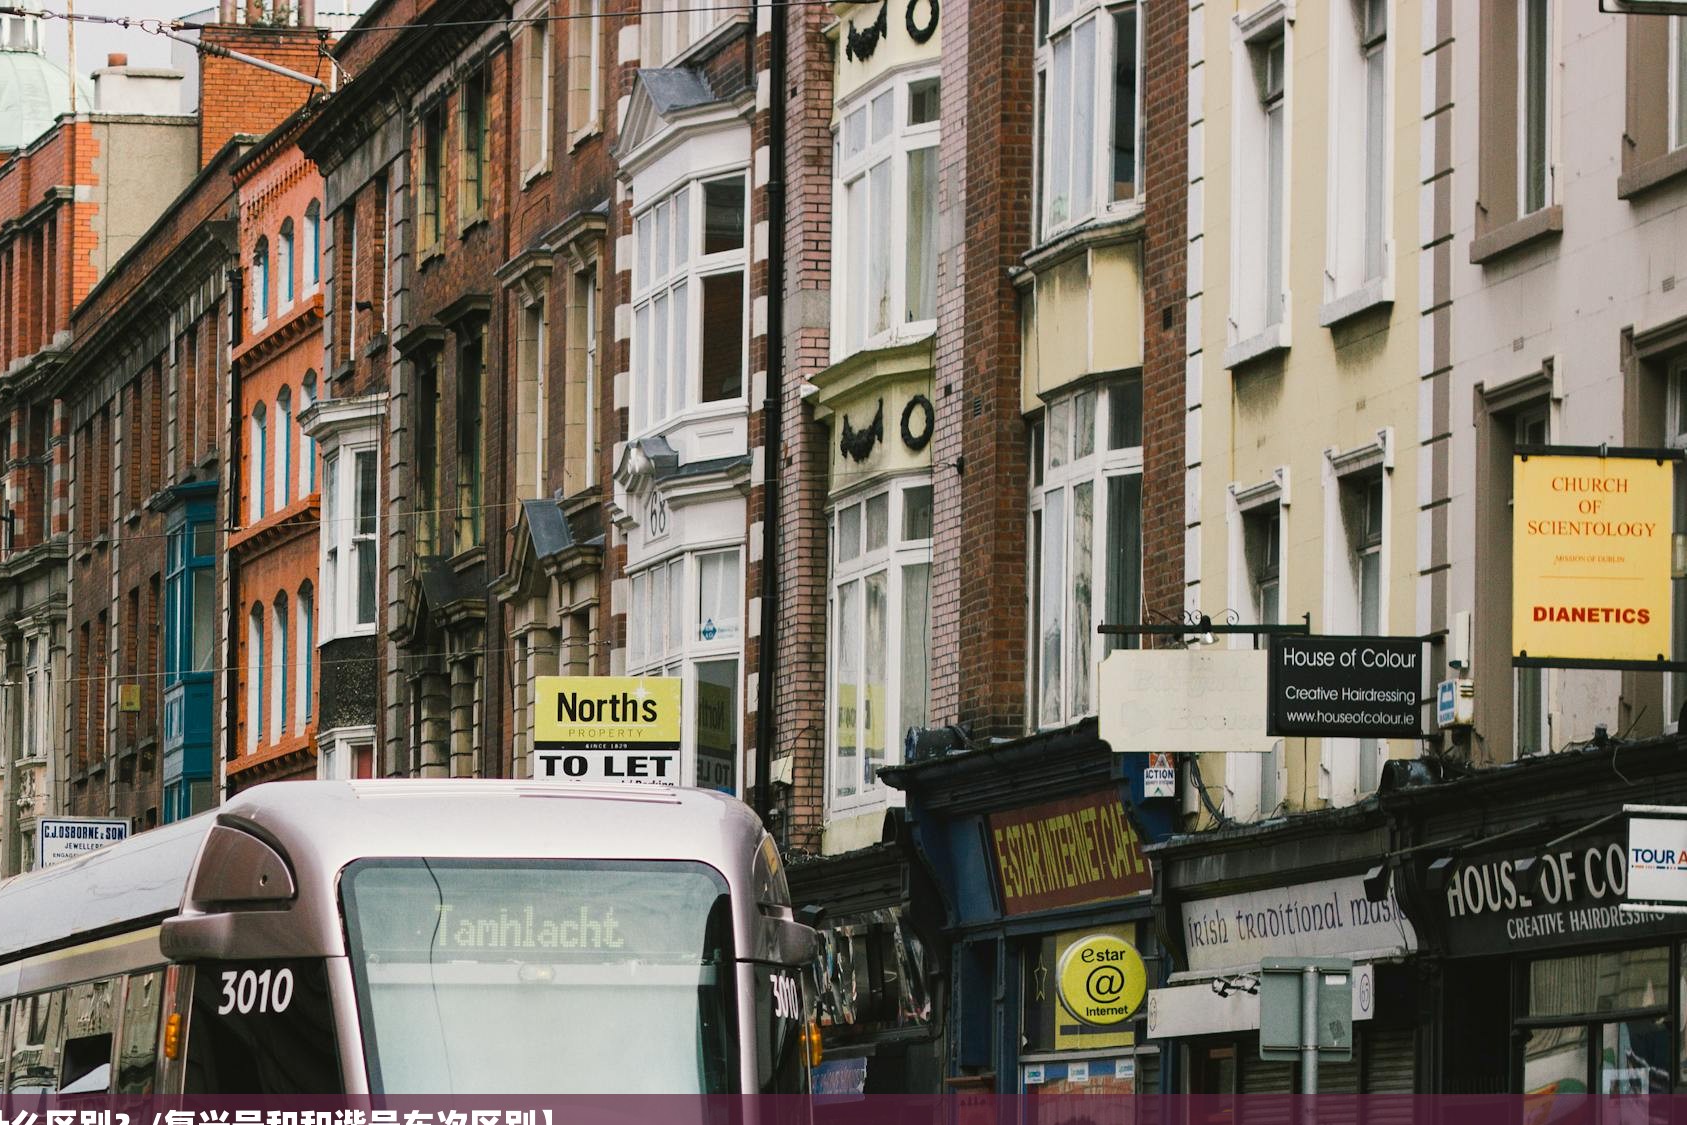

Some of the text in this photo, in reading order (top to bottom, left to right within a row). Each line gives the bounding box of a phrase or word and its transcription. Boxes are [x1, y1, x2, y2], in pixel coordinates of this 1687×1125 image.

[1552, 477, 1628, 493] CHURCH
[650, 491, 666, 536] 68
[1578, 499, 1602, 514] OF
[1527, 520, 1656, 538] SCIENTOLOGY
[1533, 606, 1651, 625] DIANETICS
[1283, 647, 1417, 668] House of Colour
[1285, 685, 1416, 706] Creative Hairdressing
[557, 692, 658, 723] Norths
[1286, 710, 1415, 726] www.houseofcolour.ie
[568, 728, 644, 738] PROPERTY
[539, 755, 673, 777] TO LET
[1145, 769, 1174, 779] ACTION
[105, 826, 124, 841] SON
[1037, 806, 1105, 892] INTERNET
[1100, 801, 1145, 880] CAFE
[1631, 848, 1676, 865] TOUR
[1447, 843, 1627, 917] HOUS OF CO
[434, 904, 625, 948] Tamhlacht
[1188, 909, 1229, 948] irish
[1235, 891, 1344, 941] traditional
[1507, 911, 1565, 940] CREATIVE
[218, 968, 294, 1016] 3010
[769, 973, 800, 1021] 3010
[1086, 1005, 1129, 1017] Internet
